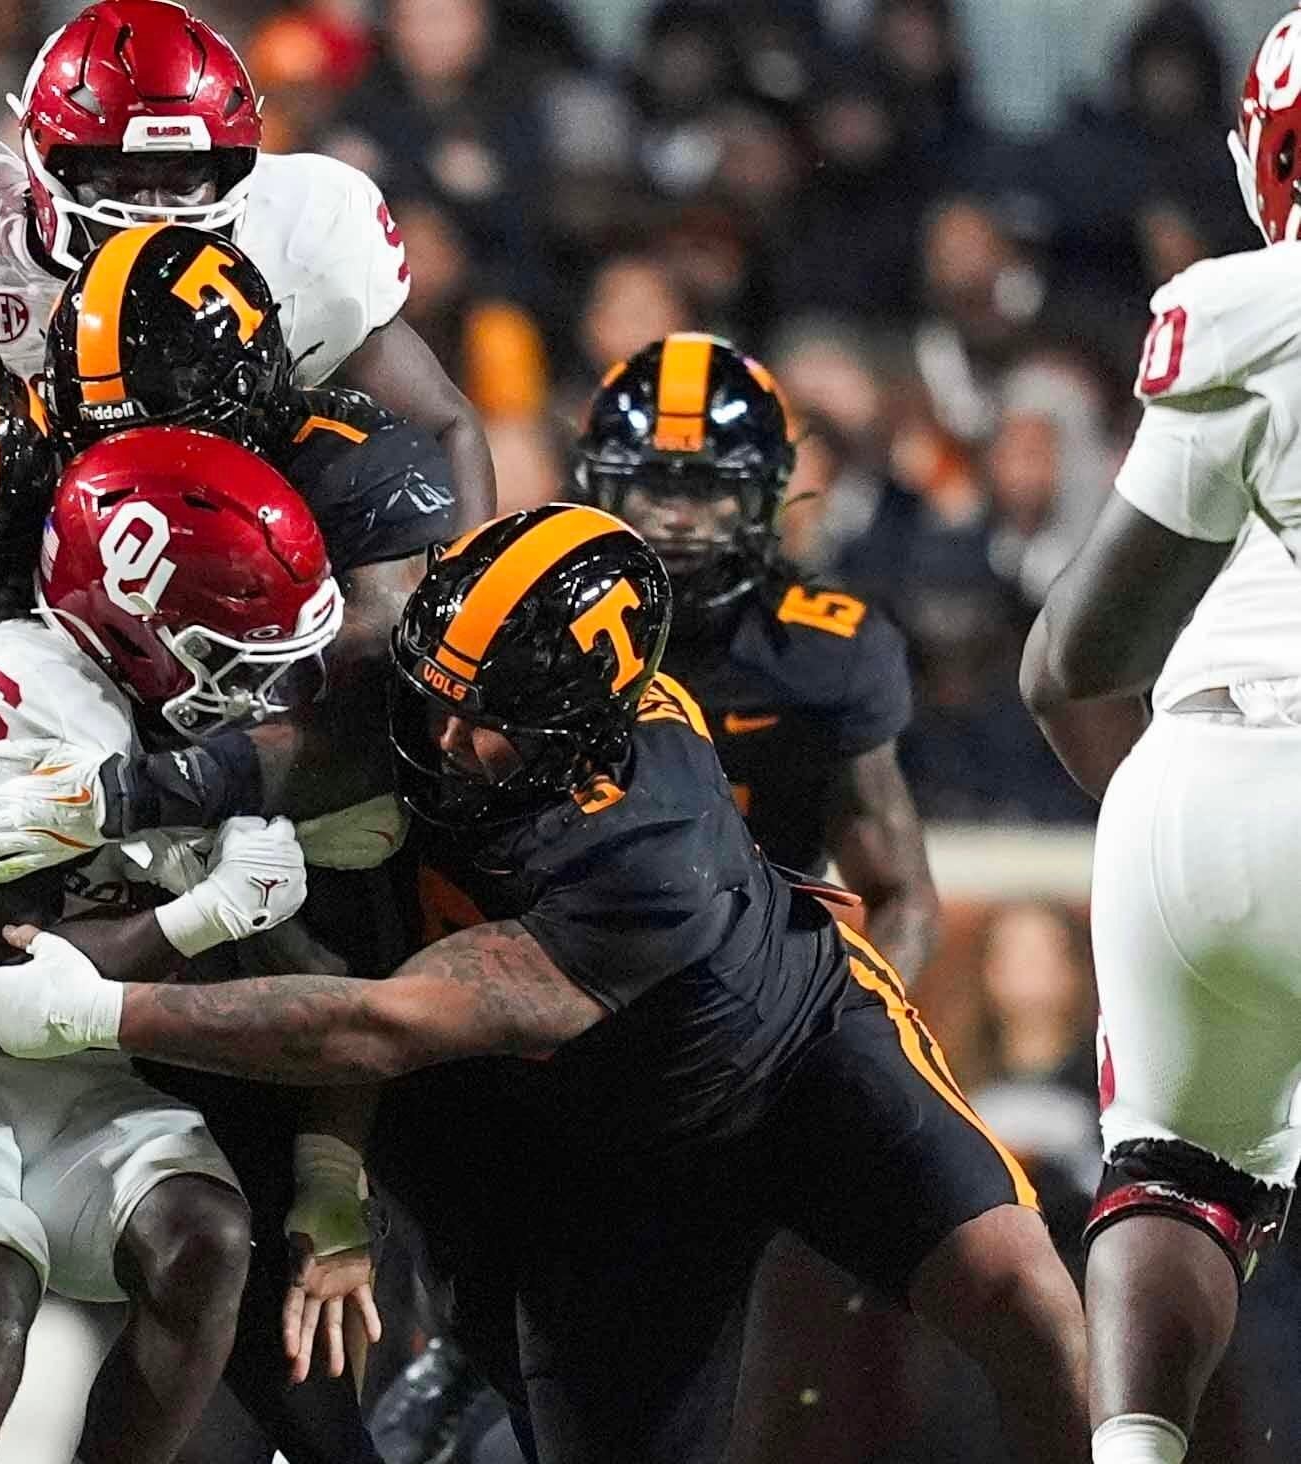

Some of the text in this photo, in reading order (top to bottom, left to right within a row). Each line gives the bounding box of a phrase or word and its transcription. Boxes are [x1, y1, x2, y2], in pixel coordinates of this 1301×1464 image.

[79, 401, 135, 421] Riddell
[99, 501, 177, 616] OU
[777, 585, 867, 639] 15
[424, 664, 467, 701] VOLS
